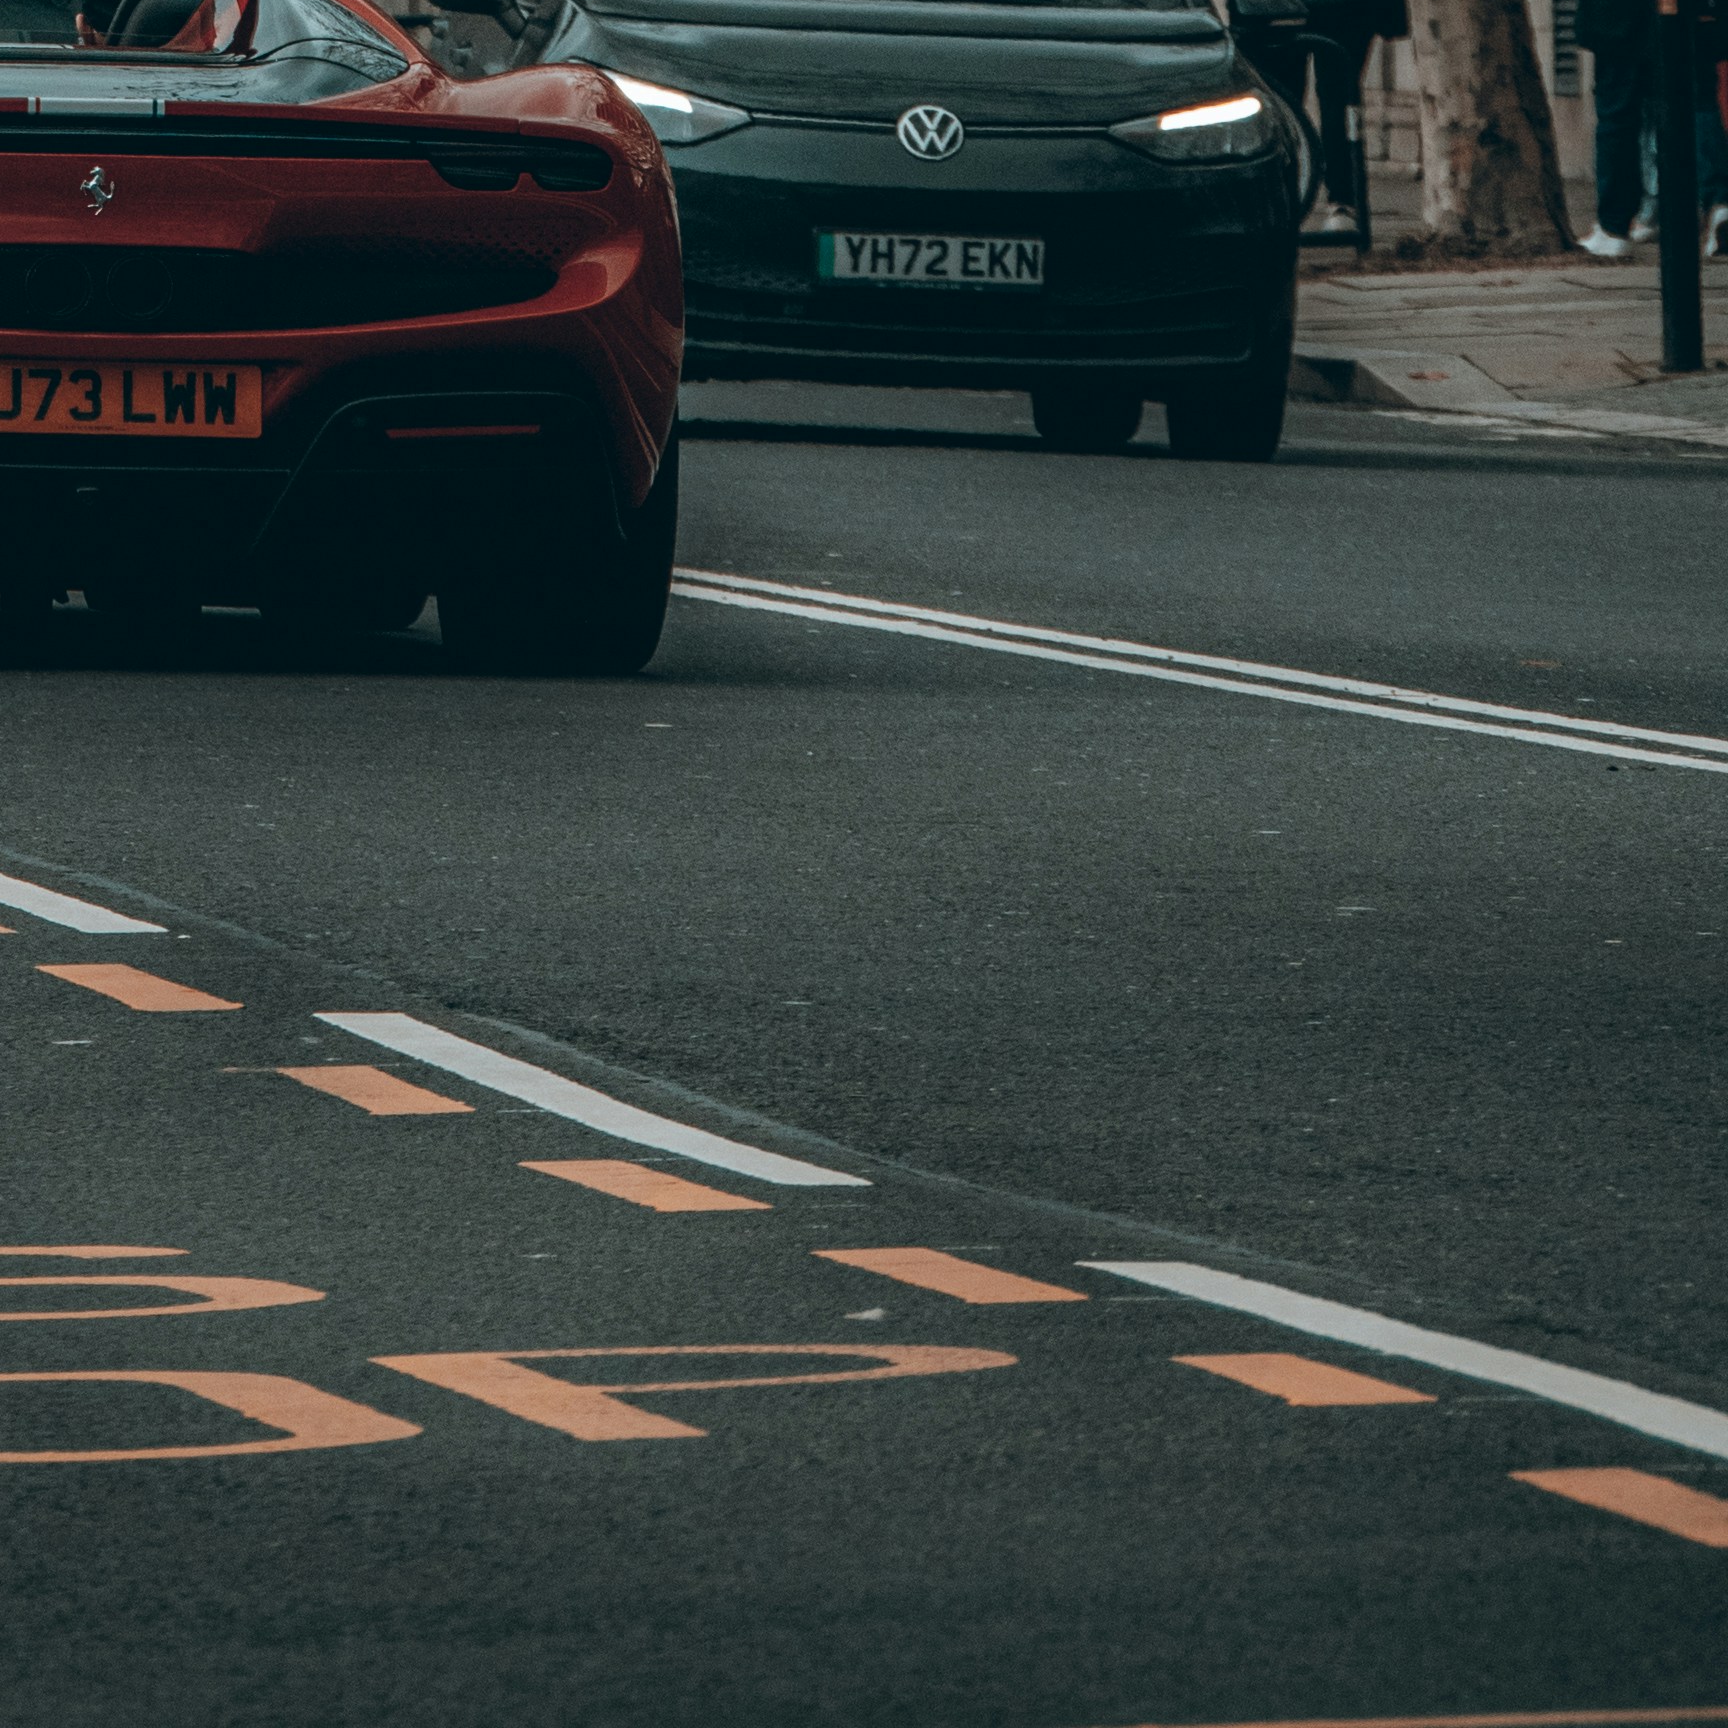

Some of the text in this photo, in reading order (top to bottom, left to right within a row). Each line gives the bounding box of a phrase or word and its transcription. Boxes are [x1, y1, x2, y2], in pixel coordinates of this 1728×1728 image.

[900, 106, 961, 155] VW
[845, 236, 1039, 280] YH72 EKN
[123, 369, 237, 426] LWW
